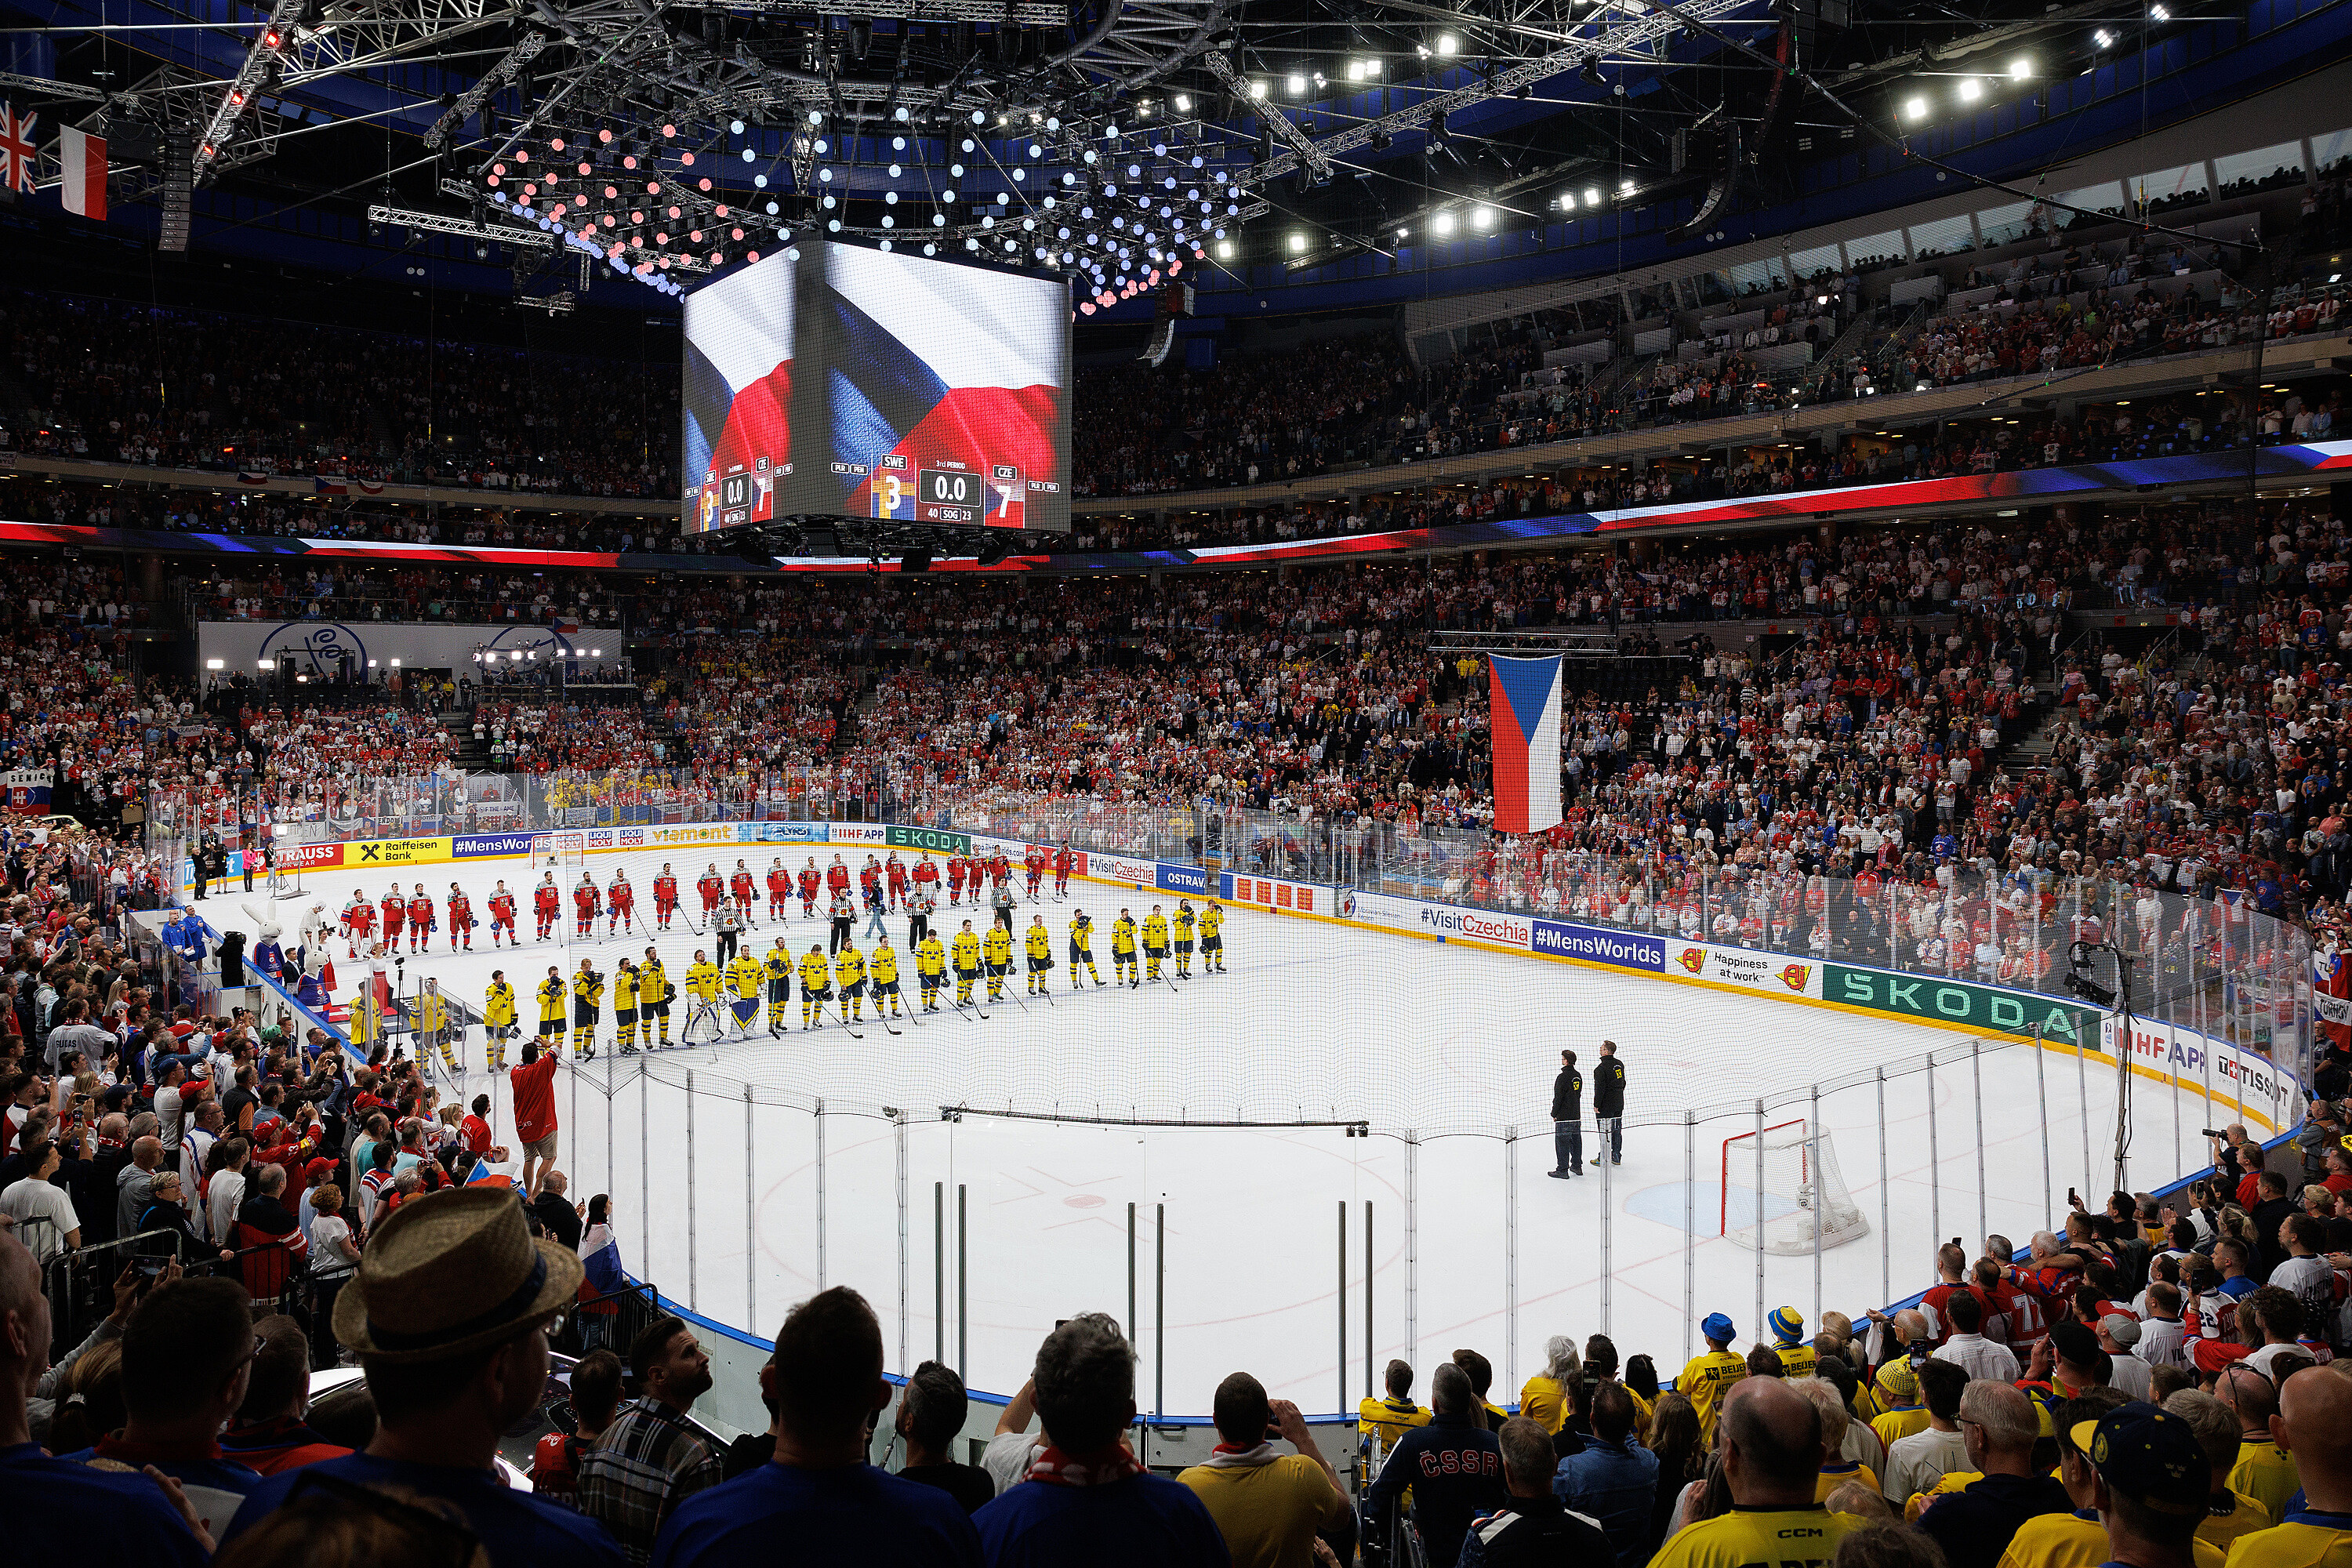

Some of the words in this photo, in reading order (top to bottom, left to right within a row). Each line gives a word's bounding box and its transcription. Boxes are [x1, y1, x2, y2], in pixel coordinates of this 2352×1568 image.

[884, 456, 904, 468] SWE
[998, 467, 1012, 477] CZE
[728, 479, 742, 504] 0.0
[758, 477, 765, 512] 7
[885, 475, 901, 510] 3
[935, 475, 966, 501] 0.0
[706, 490, 713, 522] 3
[996, 485, 1011, 518] 7
[928, 508, 938, 517] 40
[942, 510, 958, 519] SOG
[962, 510, 971, 521] 23
[652, 826, 731, 842] viamont
[839, 829, 862, 838] IIHF
[864, 829, 884, 840] APP
[386, 841, 437, 851] Raiffeisen
[456, 838, 551, 853] #MensWords
[274, 846, 335, 862] TRAUSS
[386, 851, 412, 861] Bank
[1090, 858, 1154, 881] #VisitCzechia
[1358, 913, 1374, 922] Region
[1421, 908, 1528, 941] #VisitCzechia
[1536, 928, 1662, 964] #MensWorlds
[1715, 953, 1768, 970] Happiness
[1720, 968, 1730, 978] at
[2241, 1065, 2288, 1107] TISSOT
[1721, 1363, 1746, 1374] BEIJER
[1791, 1360, 1817, 1372] BEIJER
[1420, 1450, 1498, 1478] ČSSR
[1777, 1529, 1823, 1538] CCM
